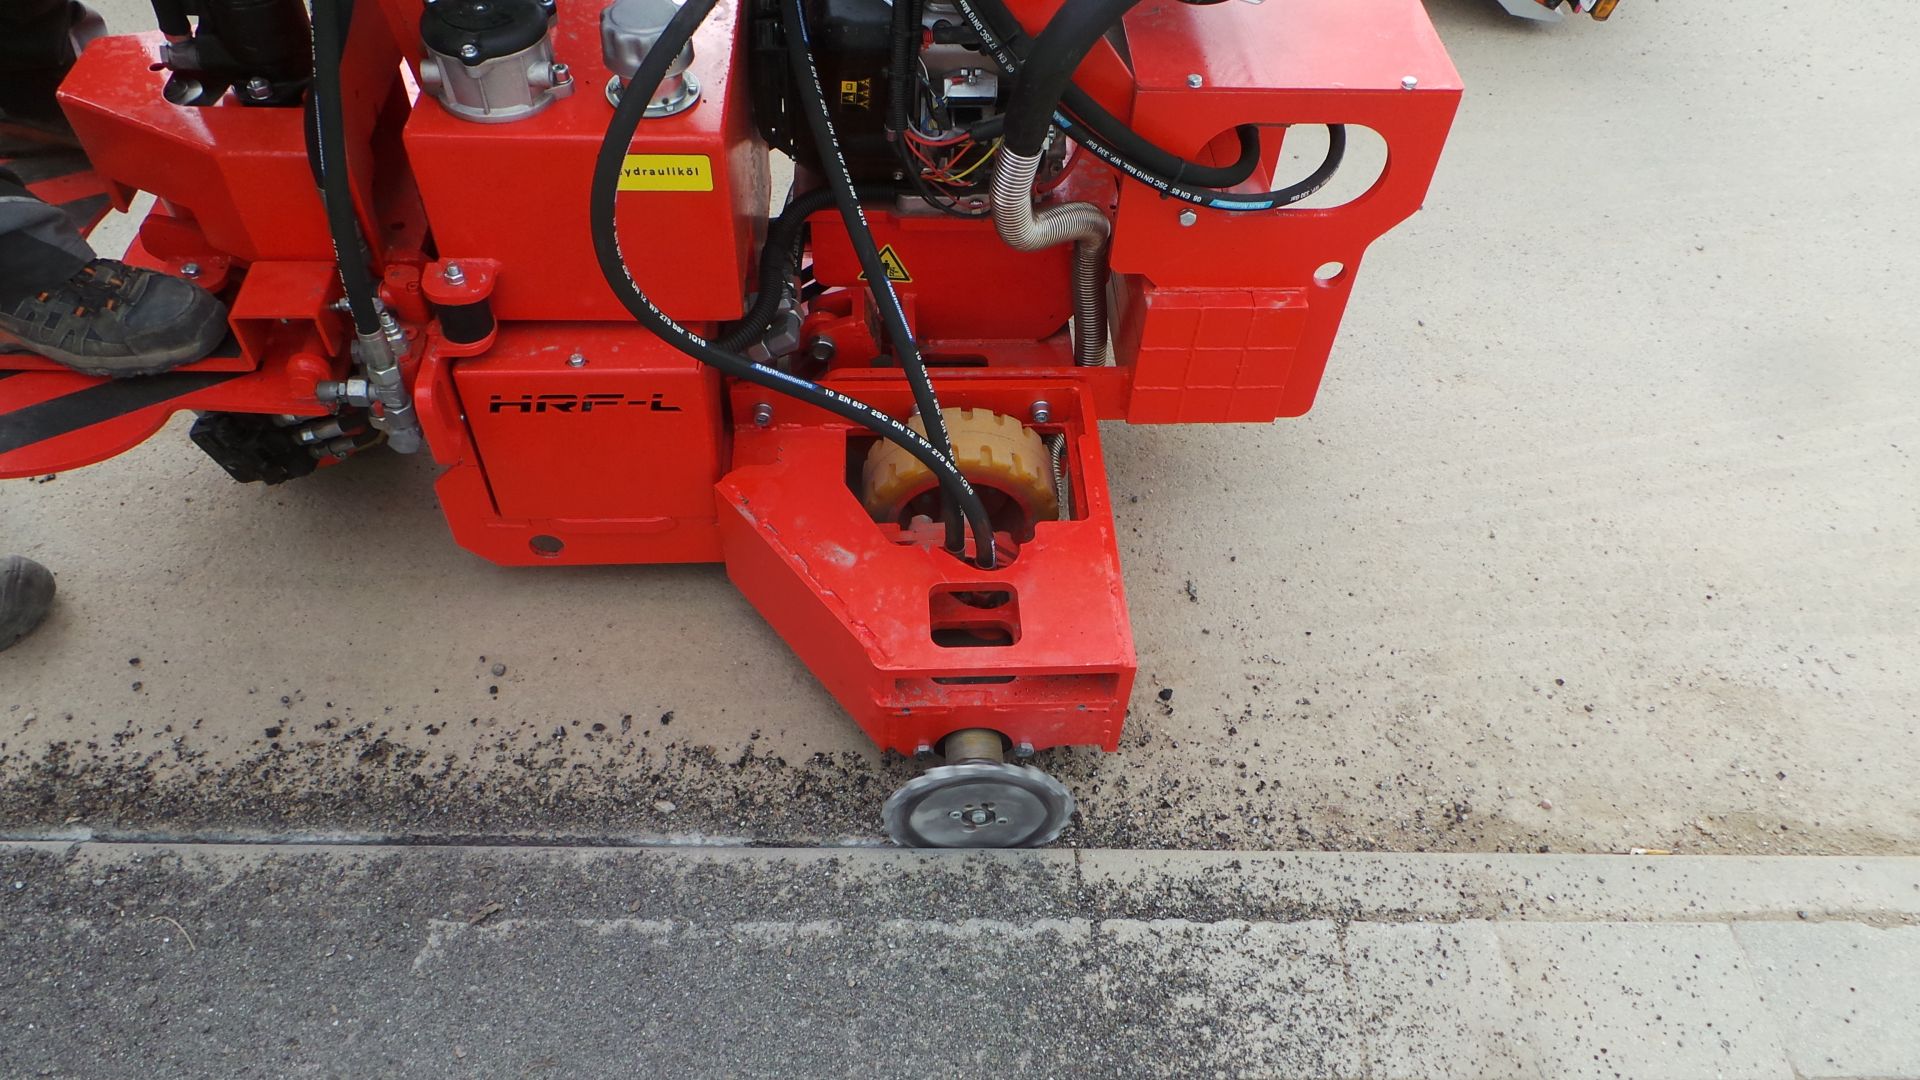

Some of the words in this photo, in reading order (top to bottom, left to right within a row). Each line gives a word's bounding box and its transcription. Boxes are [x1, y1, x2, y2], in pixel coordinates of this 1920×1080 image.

[968, 11, 983, 31] DN10
[980, 29, 993, 44] 2SC
[1086, 139, 1099, 149] Bar
[1097, 146, 1110, 158] 330
[619, 167, 699, 178] ydrauliköl
[1136, 170, 1155, 183] DN10
[1153, 180, 1169, 190] 2SC
[1179, 191, 1191, 200] EN
[648, 302, 659, 315] WP
[659, 312, 672, 326] 275
[672, 322, 685, 335] bar
[489, 393, 683, 413] HRF-L
[824, 389, 834, 397] 10
[838, 394, 851, 405] EN
[852, 400, 868, 411] 857
[870, 409, 889, 422] 2SC
[891, 420, 905, 432] DN
[906, 429, 916, 439] 12
[918, 437, 932, 450] WP
[931, 448, 946, 462] 275
[945, 460, 958, 474] bar
